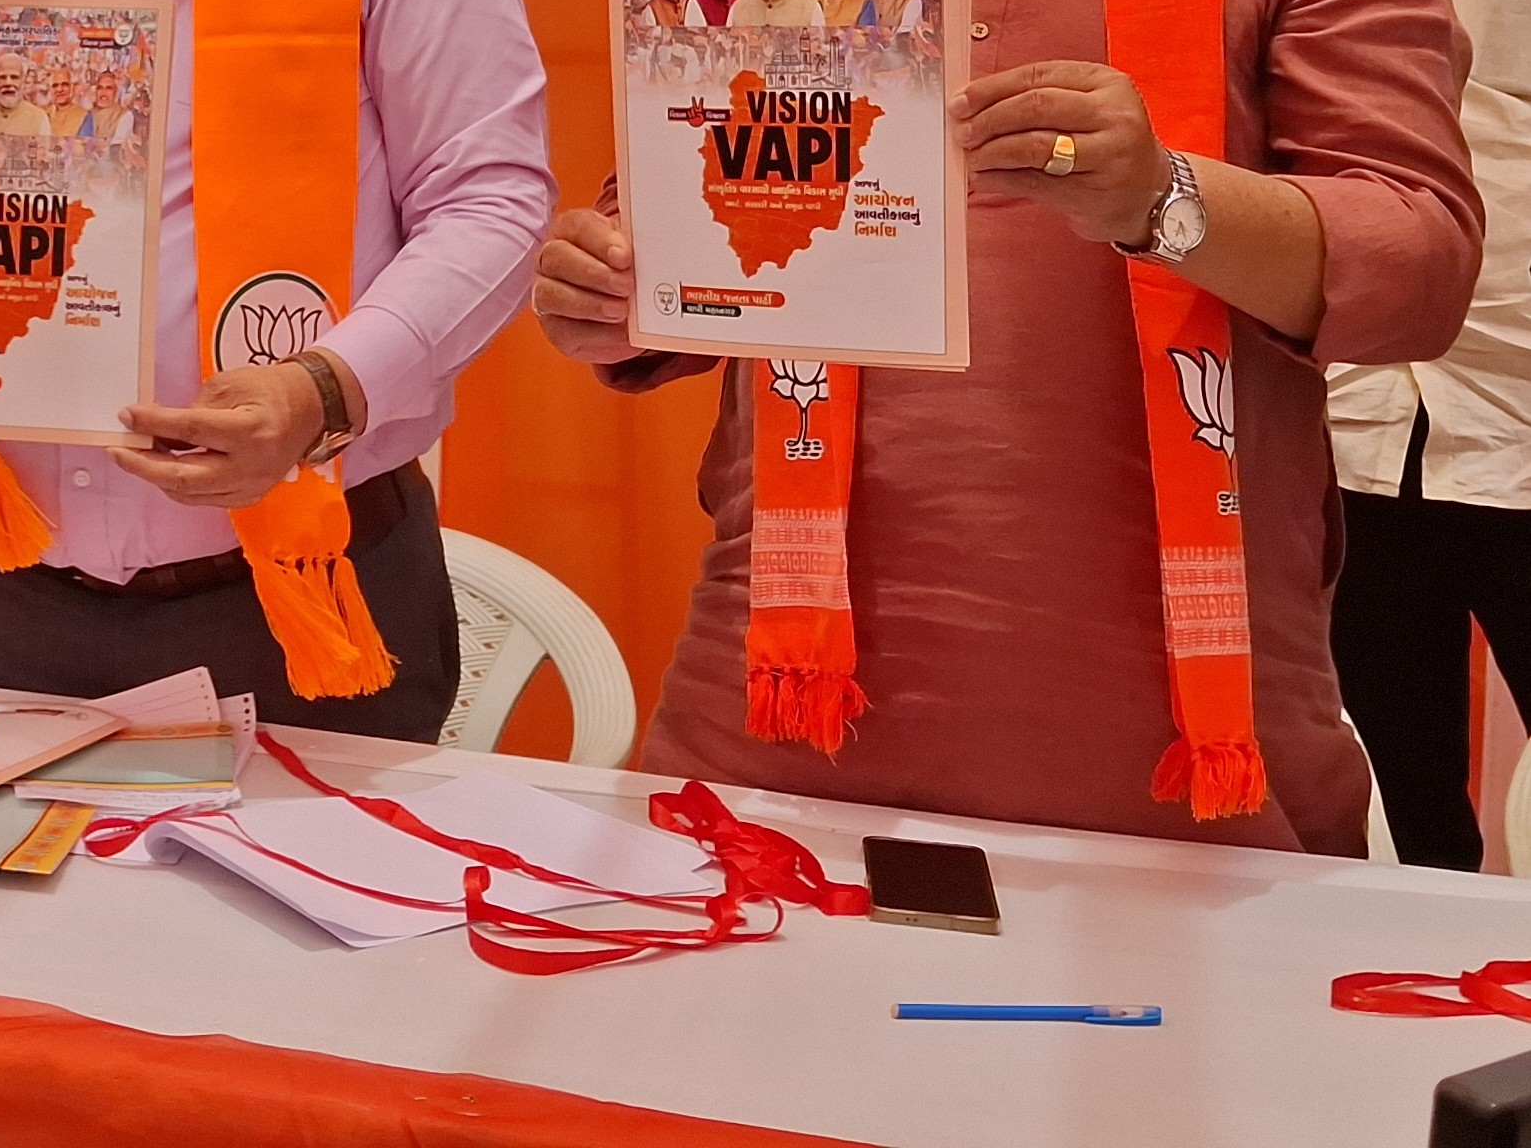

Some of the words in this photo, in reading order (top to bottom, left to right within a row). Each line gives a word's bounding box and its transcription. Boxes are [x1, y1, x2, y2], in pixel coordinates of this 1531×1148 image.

[746, 91, 851, 124] VISION
[711, 125, 851, 183] VAPI
[854, 190, 915, 207] આયોજન
[854, 208, 921, 226] આવતીકાલનું
[855, 221, 897, 237] નિર્માણ
